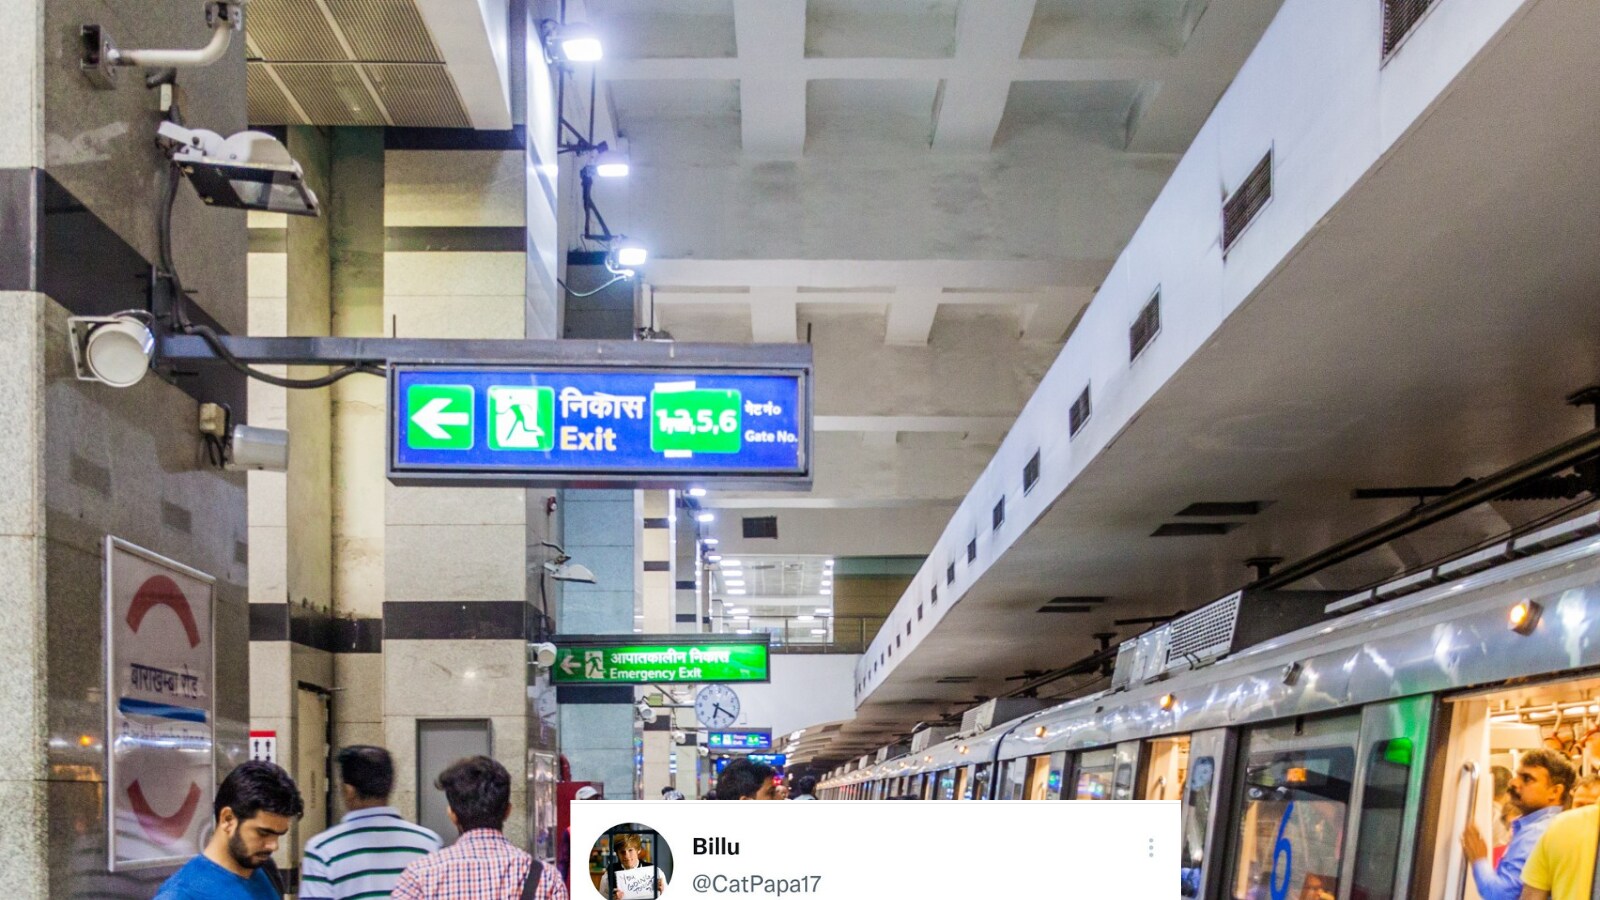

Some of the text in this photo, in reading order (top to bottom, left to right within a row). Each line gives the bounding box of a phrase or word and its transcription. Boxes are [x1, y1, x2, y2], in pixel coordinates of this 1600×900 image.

[560, 386, 647, 419] निकास
[560, 427, 617, 451] Exit
[744, 430, 798, 443] Gate No.
[610, 666, 702, 681] Emergency Exit
